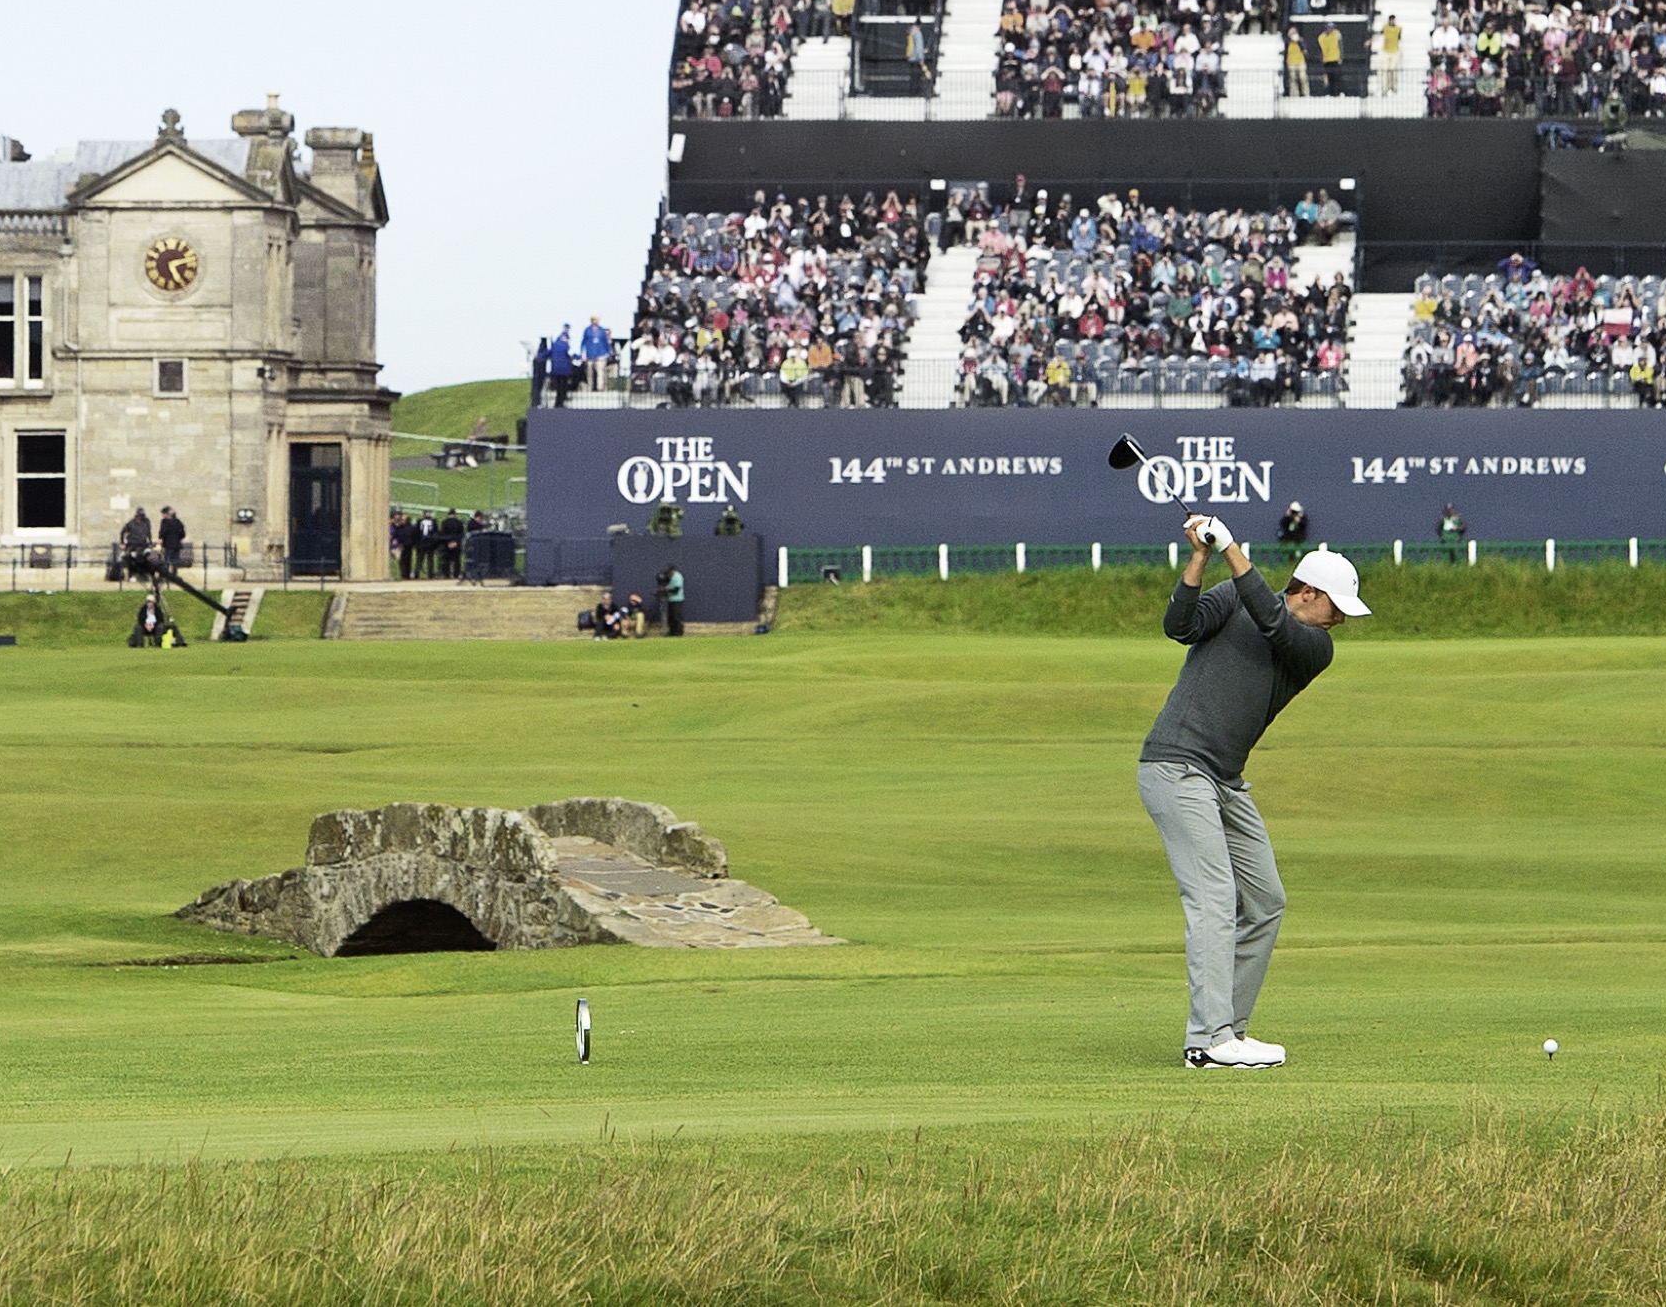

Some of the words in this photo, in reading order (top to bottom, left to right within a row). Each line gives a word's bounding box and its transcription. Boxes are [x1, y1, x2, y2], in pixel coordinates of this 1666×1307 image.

[655, 436, 715, 462] THE
[1176, 436, 1235, 461] THE
[829, 457, 903, 484] 144TH
[906, 457, 936, 475] ST
[941, 456, 1063, 475] ANDREWS
[1429, 456, 1459, 475] ST
[1464, 456, 1586, 475] ANDREWS
[617, 455, 753, 504] OPEN
[1137, 455, 1275, 504] OPEN
